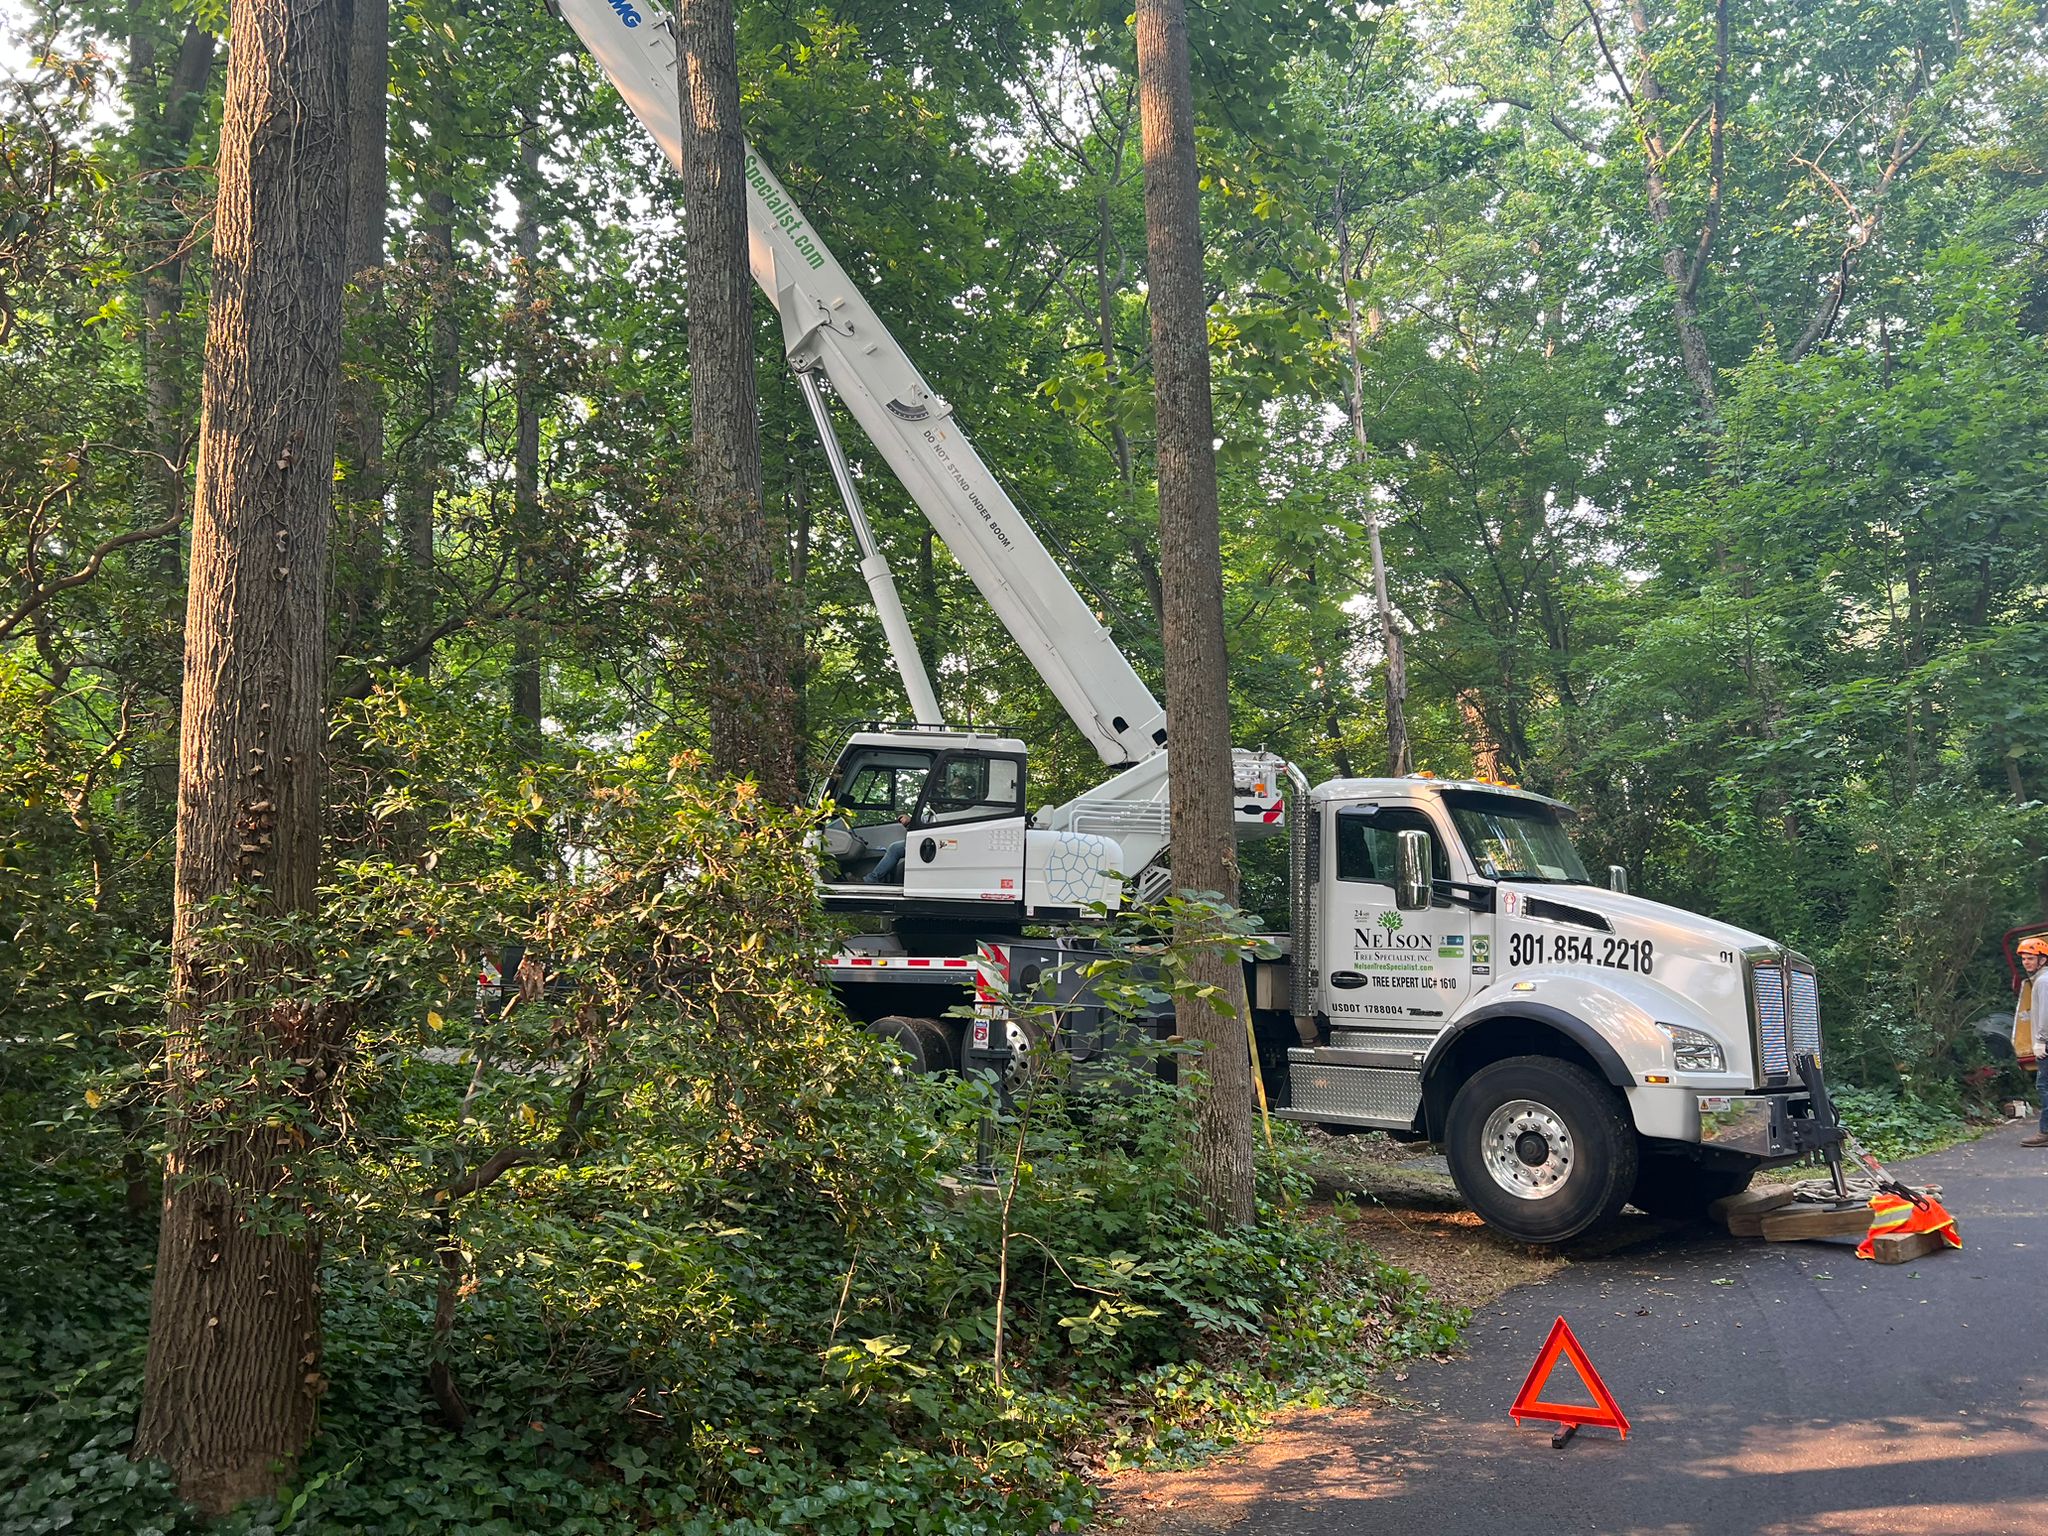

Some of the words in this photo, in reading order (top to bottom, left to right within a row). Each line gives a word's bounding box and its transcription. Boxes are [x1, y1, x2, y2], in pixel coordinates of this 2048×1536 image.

[923, 430, 936, 444] DO
[933, 444, 950, 464] NOT
[947, 463, 970, 492] STAND
[968, 492, 992, 522] UNDER
[989, 521, 1011, 549] BOOM
[1509, 932, 1654, 975] 301.854.2218
[1719, 951, 1733, 963] 01
[1353, 962, 1434, 972] NelsonTreeSpecialist.com
[1372, 976, 1390, 988] TREE
[1392, 976, 1419, 989] EXPERT
[1421, 977, 1438, 989] LIC#
[1440, 977, 1457, 990] 1610
[1332, 1003, 1360, 1013] USDOT
[1364, 1004, 1403, 1015] 1788004
